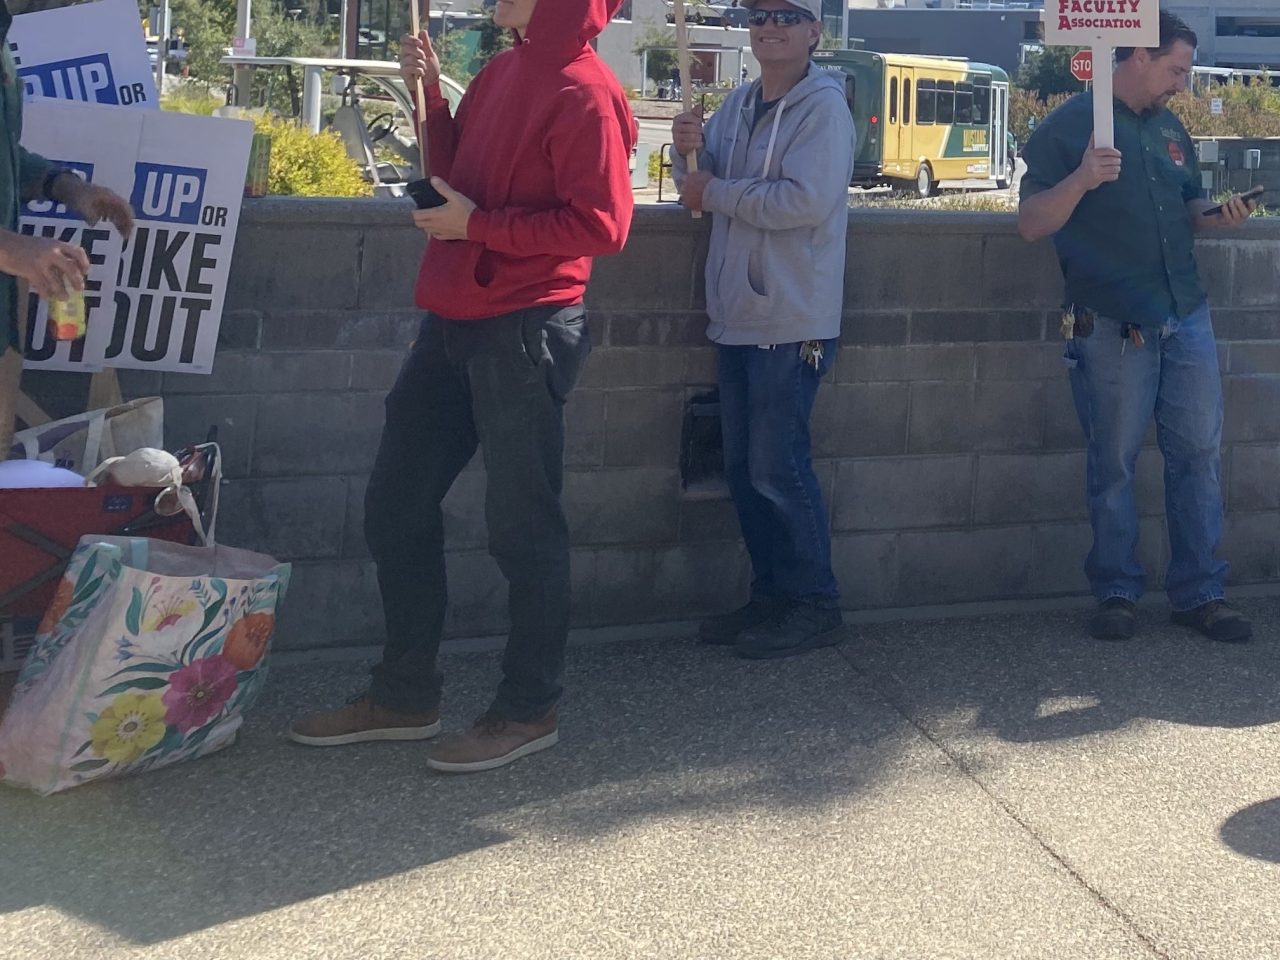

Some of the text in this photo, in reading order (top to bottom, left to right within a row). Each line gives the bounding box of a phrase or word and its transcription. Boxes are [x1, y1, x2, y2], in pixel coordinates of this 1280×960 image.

[1073, 59, 1092, 71] STO
[119, 83, 147, 105] OR
[142, 170, 228, 227] UP OR
